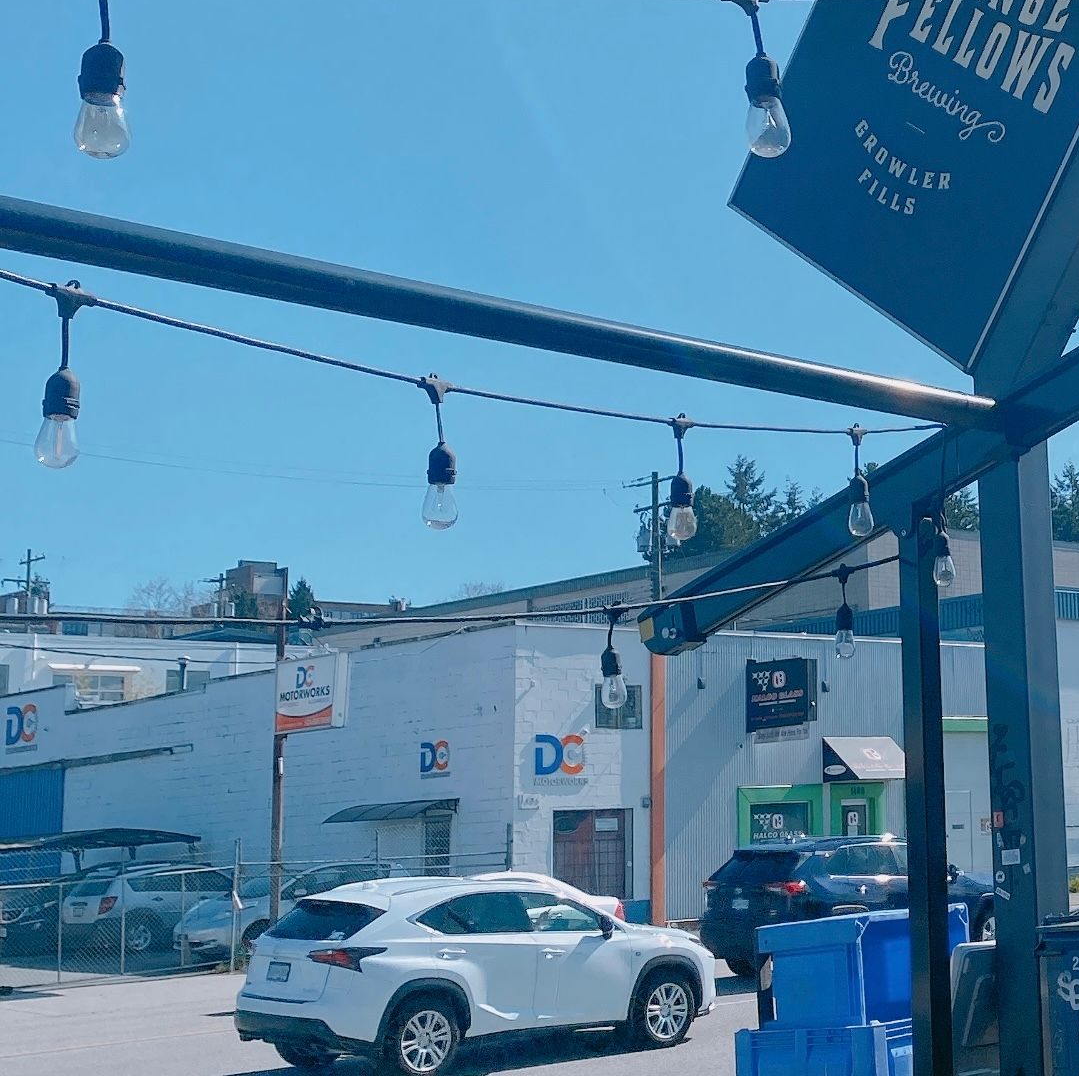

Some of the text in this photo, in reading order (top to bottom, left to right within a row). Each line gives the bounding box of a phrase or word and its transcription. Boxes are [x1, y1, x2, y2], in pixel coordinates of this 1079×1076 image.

[887, 50, 1006, 143] Brewing
[854, 119, 951, 190] GROWLER
[857, 168, 916, 215] FILLS
[279, 685, 331, 702] MOTORWORKS
[295, 665, 315, 689] DC
[5, 704, 38, 745] DC
[420, 740, 449, 772] DC
[535, 734, 585, 775] DC
[753, 831, 778, 840] HALCO
